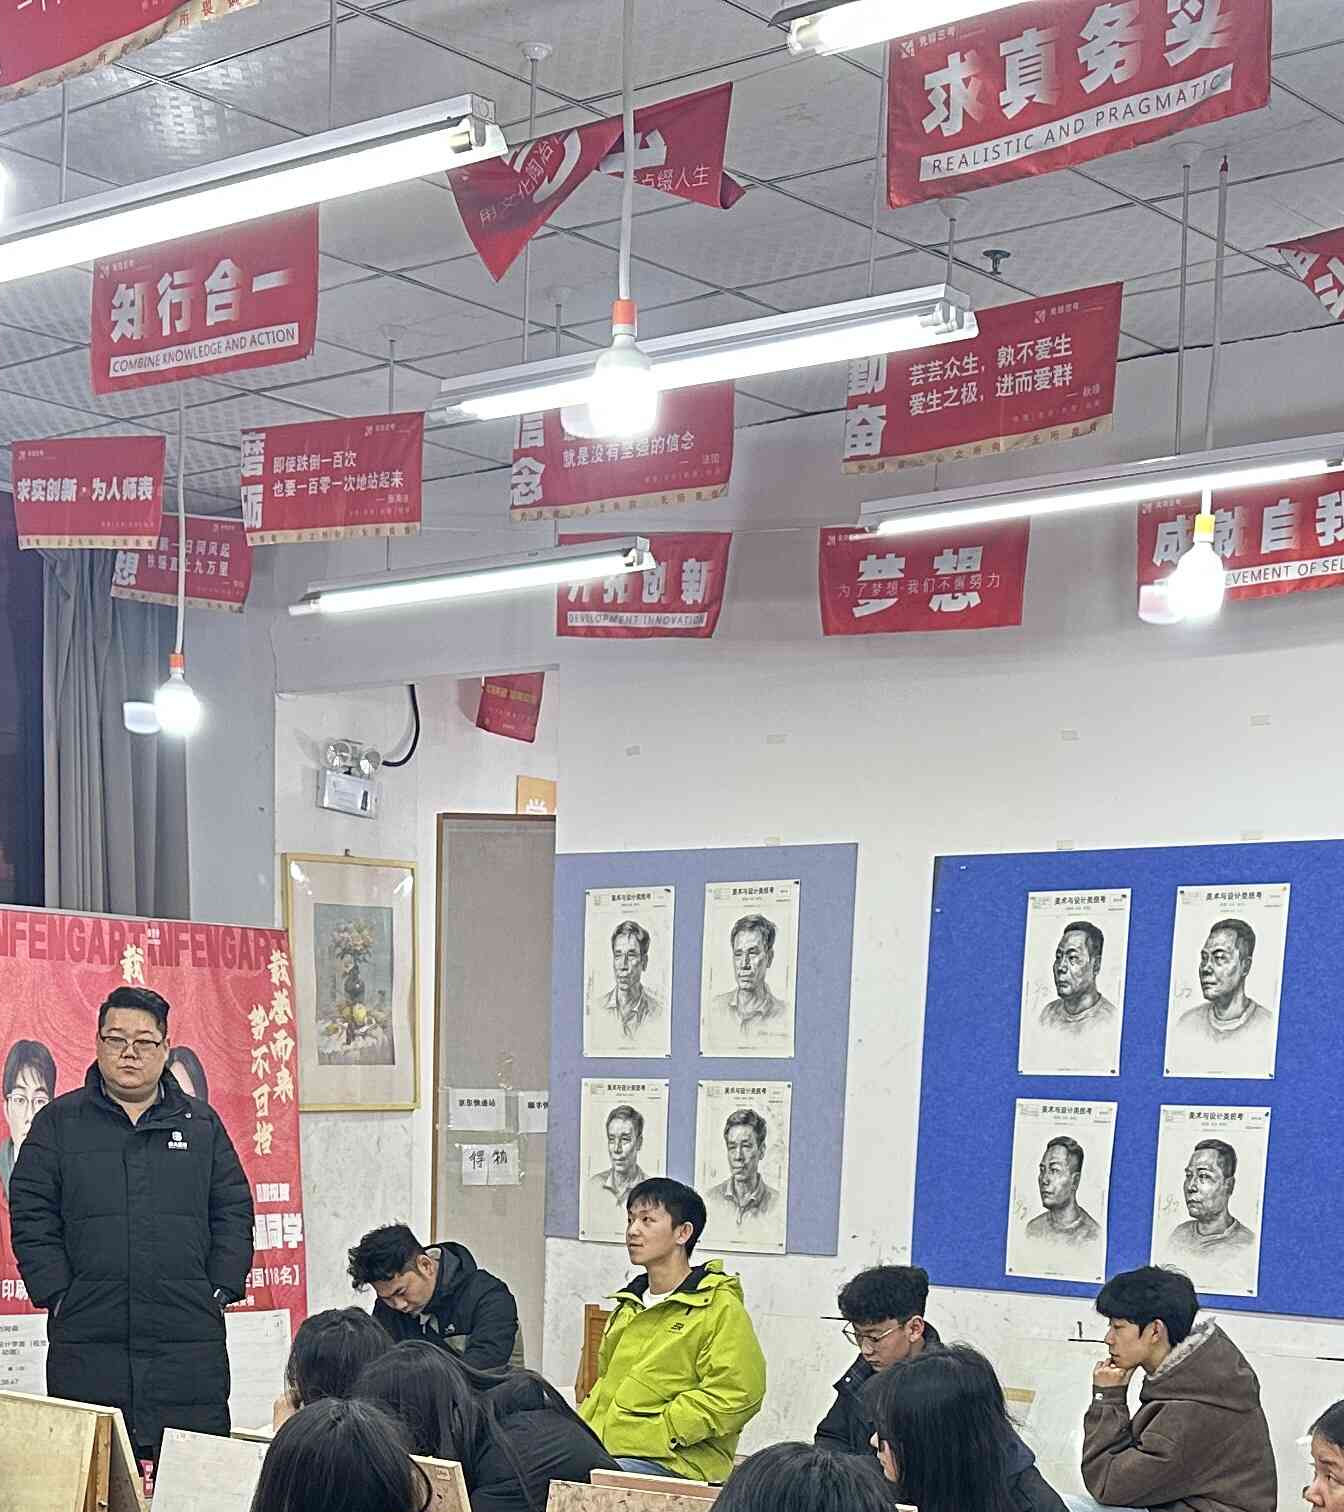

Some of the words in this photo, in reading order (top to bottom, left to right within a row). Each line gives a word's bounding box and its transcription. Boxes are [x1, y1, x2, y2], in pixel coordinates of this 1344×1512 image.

[931, 133, 1034, 175] REALISTIC
[1043, 117, 1086, 145] AND
[1095, 73, 1224, 128] PRAGMATIC
[110, 258, 290, 343] 知行合一
[112, 355, 160, 374] COMBINE
[162, 341, 223, 366] KNOWLEDGE
[224, 335, 247, 350] AND
[249, 328, 296, 346] ACTION
[273, 450, 357, 474] 即使跌倒一百次
[16, 476, 154, 503] 求实创新·为人师表
[273, 470, 404, 497] 也要一百零一次地站起来
[852, 545, 984, 619] 梦想
[1297, 562, 1318, 577] OF
